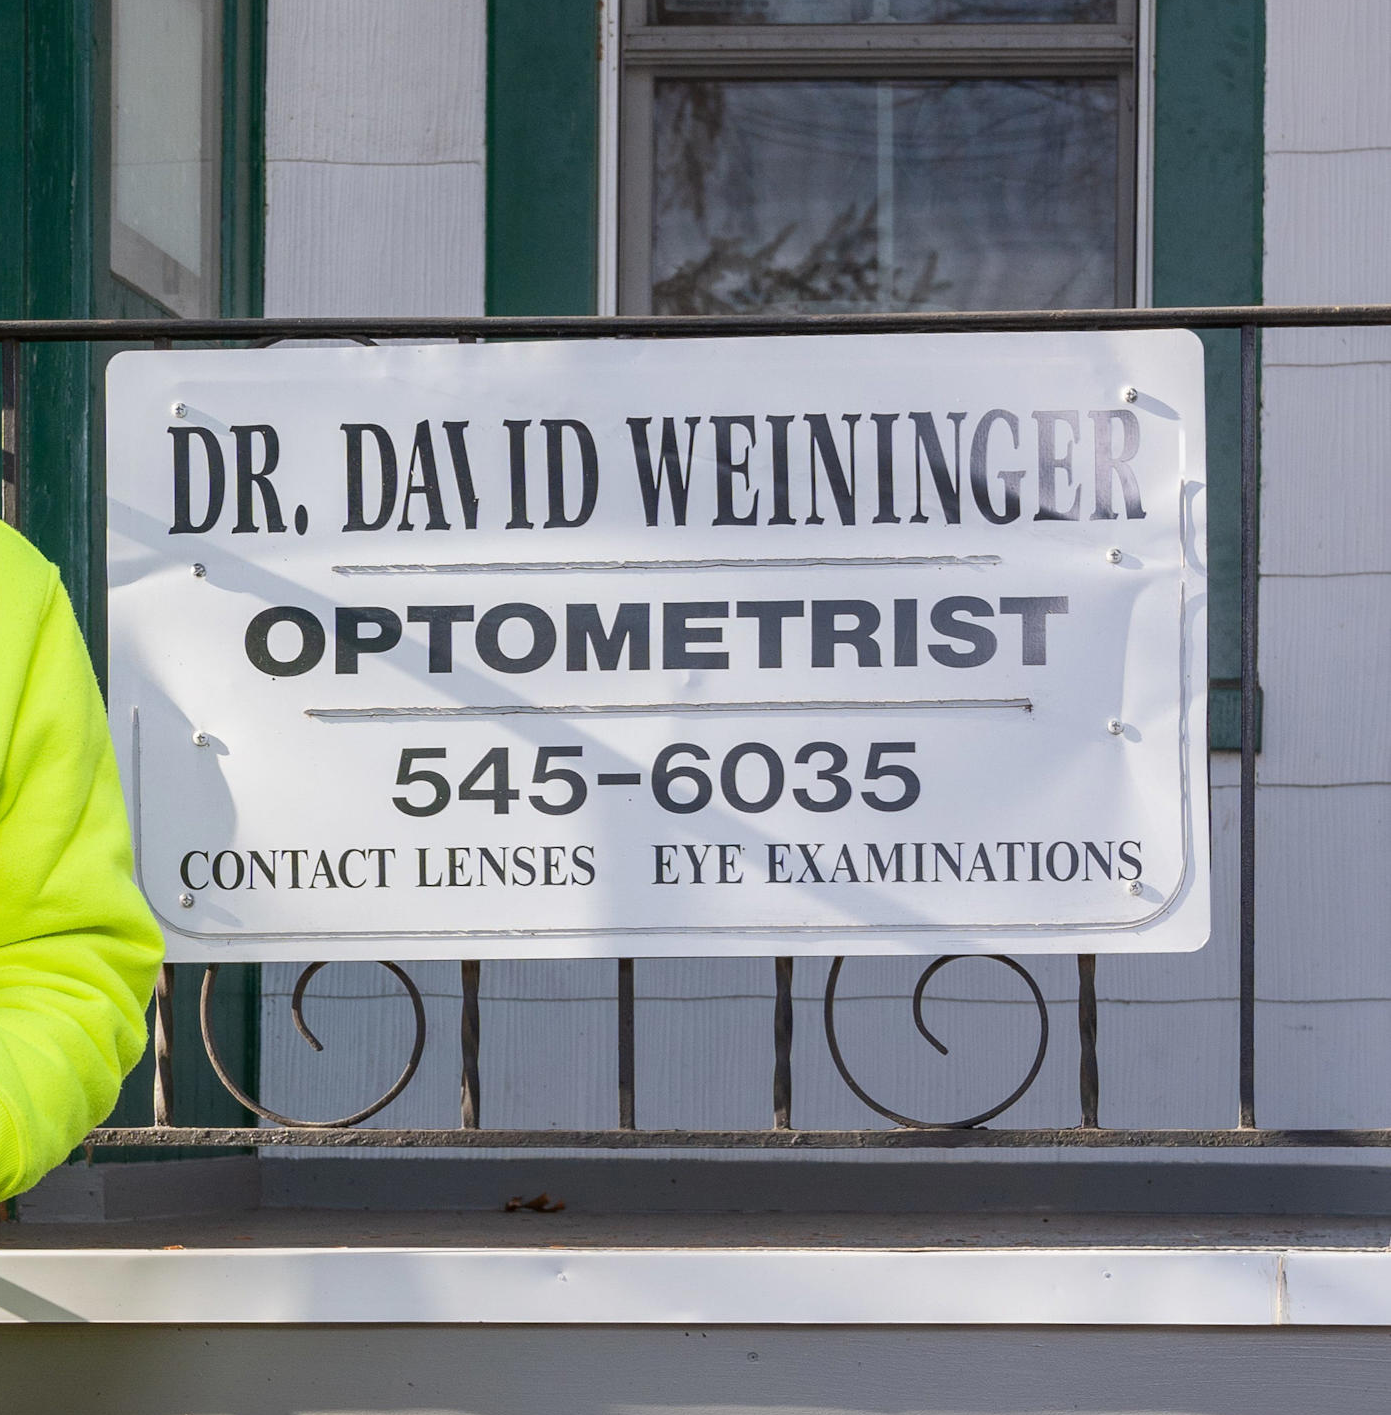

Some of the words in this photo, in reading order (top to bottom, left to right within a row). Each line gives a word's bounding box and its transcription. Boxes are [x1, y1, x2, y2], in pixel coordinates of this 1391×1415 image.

[167, 423, 309, 537] DR.
[339, 418, 599, 533] DAVID
[625, 407, 1148, 528] WEININGER
[244, 595, 1071, 678] OPTOMETRIST
[391, 741, 921, 818] 545-6035
[179, 848, 397, 891] CONTACT
[414, 845, 596, 888] LENSES
[650, 843, 744, 885] EYE
[764, 840, 1143, 884] EXAMINATIONS
